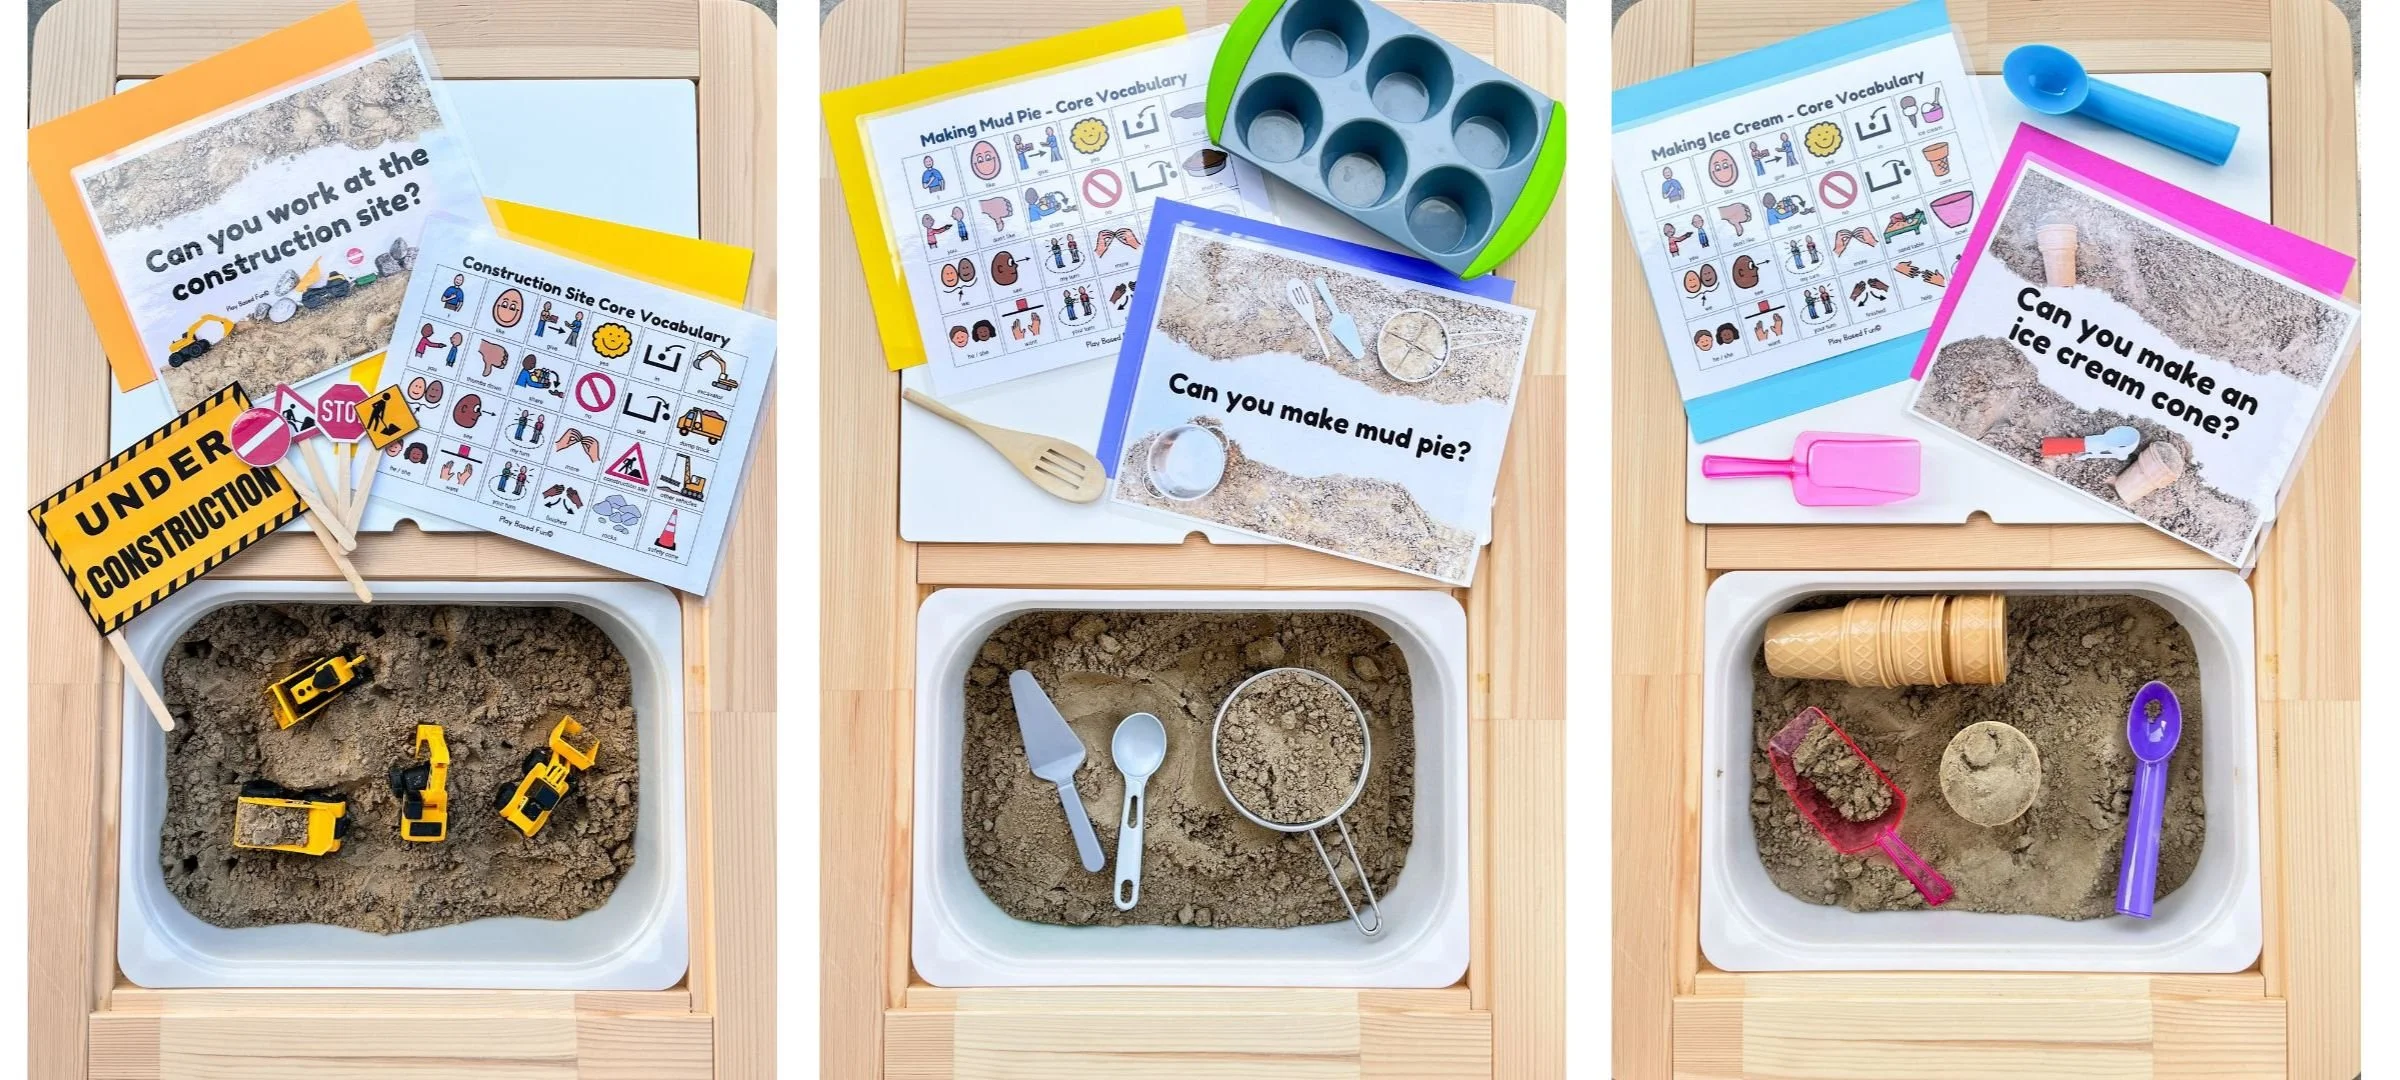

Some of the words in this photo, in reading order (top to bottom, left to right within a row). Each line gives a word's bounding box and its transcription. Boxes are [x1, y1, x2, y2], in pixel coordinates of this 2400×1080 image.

[920, 124, 978, 147] Making
[979, 112, 1015, 132] Mud
[1017, 108, 1042, 123] Pie
[1057, 95, 1094, 114] Core
[1096, 73, 1188, 104] Vocabulary
[1651, 137, 1707, 162] Making
[1708, 129, 1731, 144] Ice
[1733, 113, 1784, 136] Cream
[1797, 99, 1834, 117] Core
[1835, 71, 1925, 105] Vocabulary
[146, 240, 204, 273] Can
[206, 215, 263, 255] you
[266, 181, 340, 225] work
[343, 166, 376, 194] at
[378, 148, 430, 178] the
[172, 218, 352, 302] construction
[356, 182, 421, 227] site?
[463, 256, 562, 296] Construction
[565, 287, 596, 307] Site
[598, 298, 636, 319] Core
[640, 309, 731, 349] Vocabulary
[1086, 340, 1100, 349] Play
[1101, 335, 1122, 346] Based
[1828, 335, 1843, 346] Play
[1843, 330, 1864, 341] Based
[2009, 316, 2052, 356] ice
[2056, 346, 2146, 400] cream
[2151, 389, 2240, 441] cone?
[2017, 287, 2072, 330] Can
[2076, 318, 2134, 358] you
[2137, 346, 2217, 398] make
[2221, 386, 2260, 417] an
[321, 400, 362, 424] STO
[1168, 372, 1219, 403] Can
[1226, 390, 1274, 417] you
[1279, 403, 1350, 435] make
[1354, 421, 1413, 450] mud
[1416, 432, 1472, 463] pie?
[74, 429, 233, 537] UNDER
[499, 516, 513, 528] Play
[513, 520, 535, 534] Based
[603, 476, 637, 491] construction
[660, 492, 676, 502] other
[86, 467, 283, 600] CONSTRUCTION
